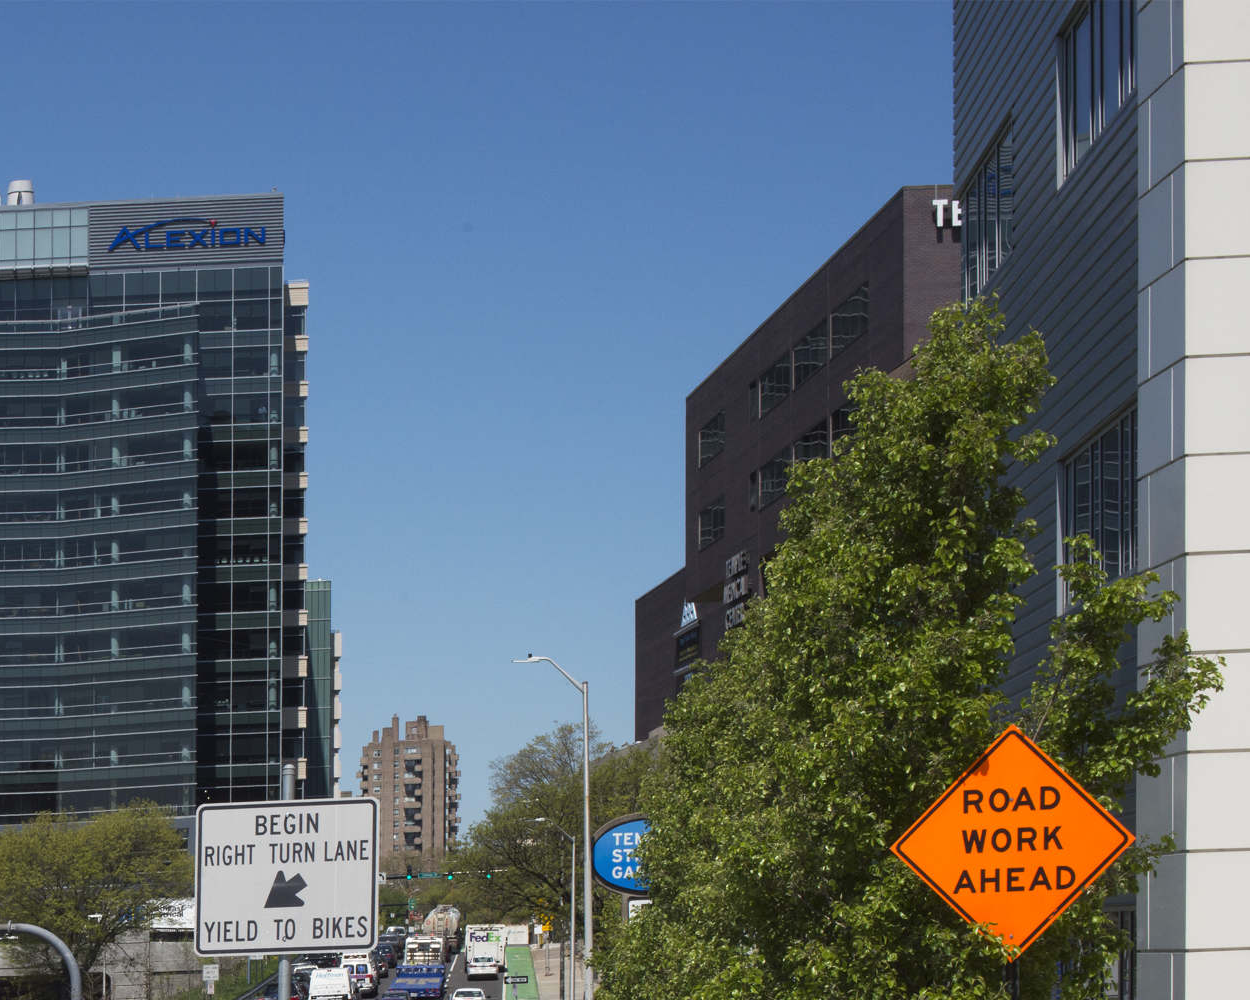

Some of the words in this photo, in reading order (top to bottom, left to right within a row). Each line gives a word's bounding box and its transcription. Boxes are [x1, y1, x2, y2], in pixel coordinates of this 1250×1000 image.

[963, 786, 1061, 814] ROAD
[255, 812, 319, 836] BEGIN
[204, 844, 256, 867] RIGHT
[269, 841, 315, 864] TURN
[324, 839, 369, 862] LANE
[962, 826, 1063, 854] WORK
[953, 866, 1076, 894] AHEAD
[204, 920, 258, 943] YIELD
[274, 918, 296, 942] TO
[312, 916, 368, 939] BIKES
[470, 932, 501, 942] FedEx
